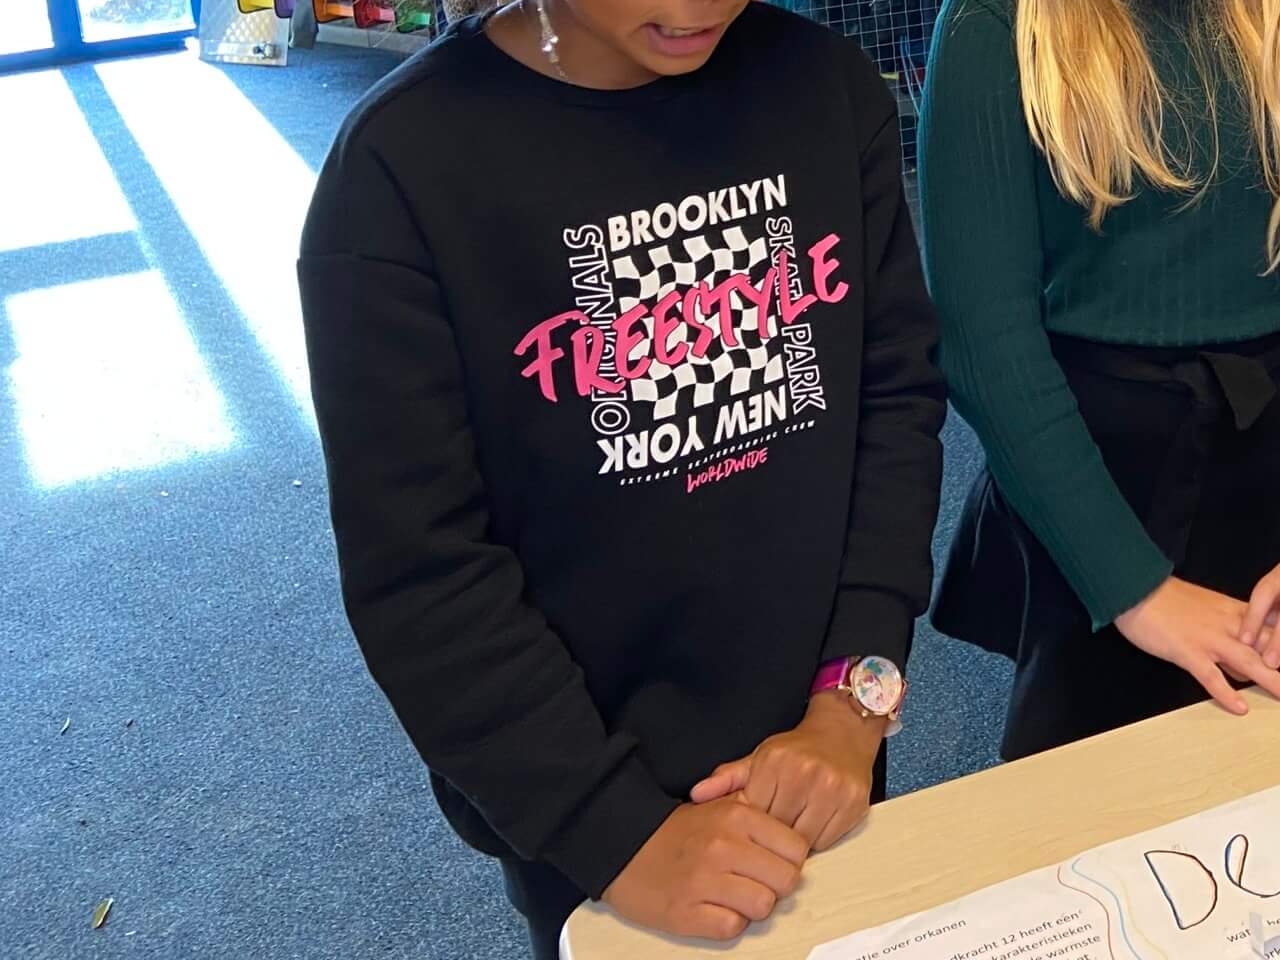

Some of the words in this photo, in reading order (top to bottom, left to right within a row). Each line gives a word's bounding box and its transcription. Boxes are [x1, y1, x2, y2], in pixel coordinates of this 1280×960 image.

[607, 173, 788, 252] BROOKLYN
[513, 232, 850, 403] FREESTYLE
[781, 322, 827, 416] PARK
[714, 385, 787, 444] NEW
[597, 415, 705, 475] YORK
[619, 467, 679, 487] EXTREME
[687, 430, 779, 470] SKATEBOARDING
[784, 419, 816, 435] CREW
[882, 938, 912, 955] over
[914, 920, 968, 943] orkanen
[1001, 934, 1017, 946] 12
[1019, 921, 1055, 939] heeft
[1046, 935, 1101, 959] warmste
